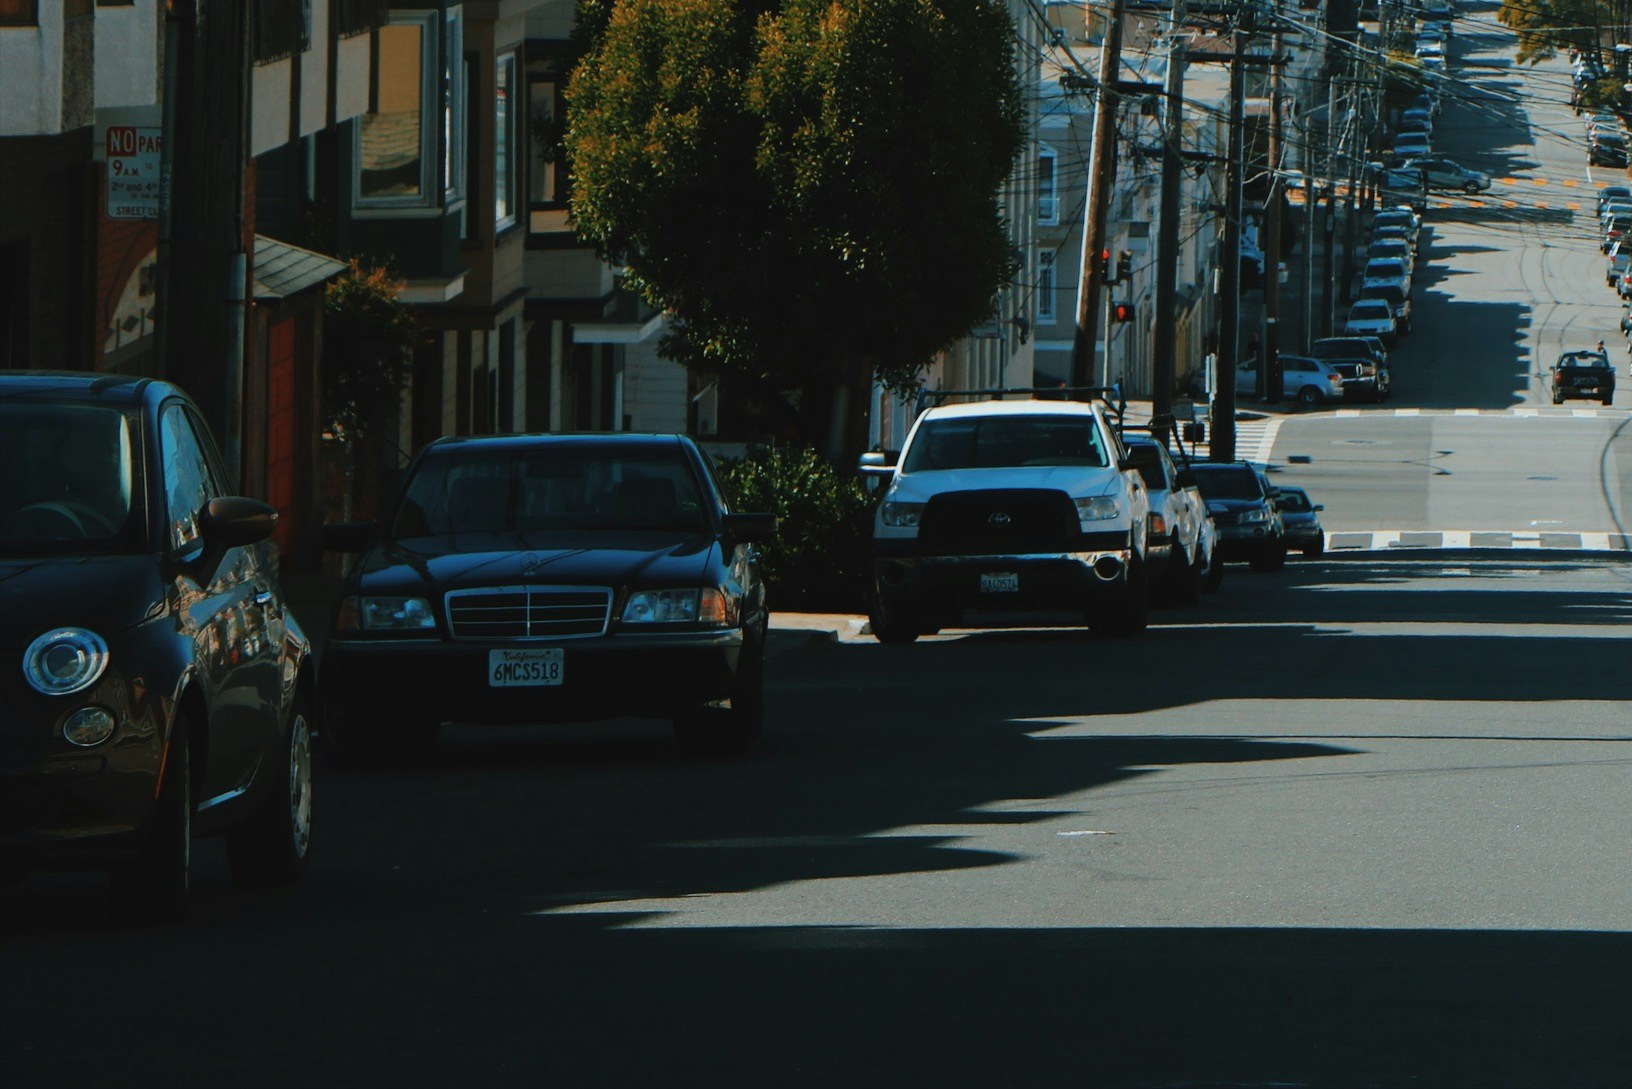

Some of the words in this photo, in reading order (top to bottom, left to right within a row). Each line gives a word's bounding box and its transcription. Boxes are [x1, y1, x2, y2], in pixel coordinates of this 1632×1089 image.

[110, 129, 134, 153] NO
[116, 206, 145, 216] STREET
[494, 662, 559, 681] 6MCS518
